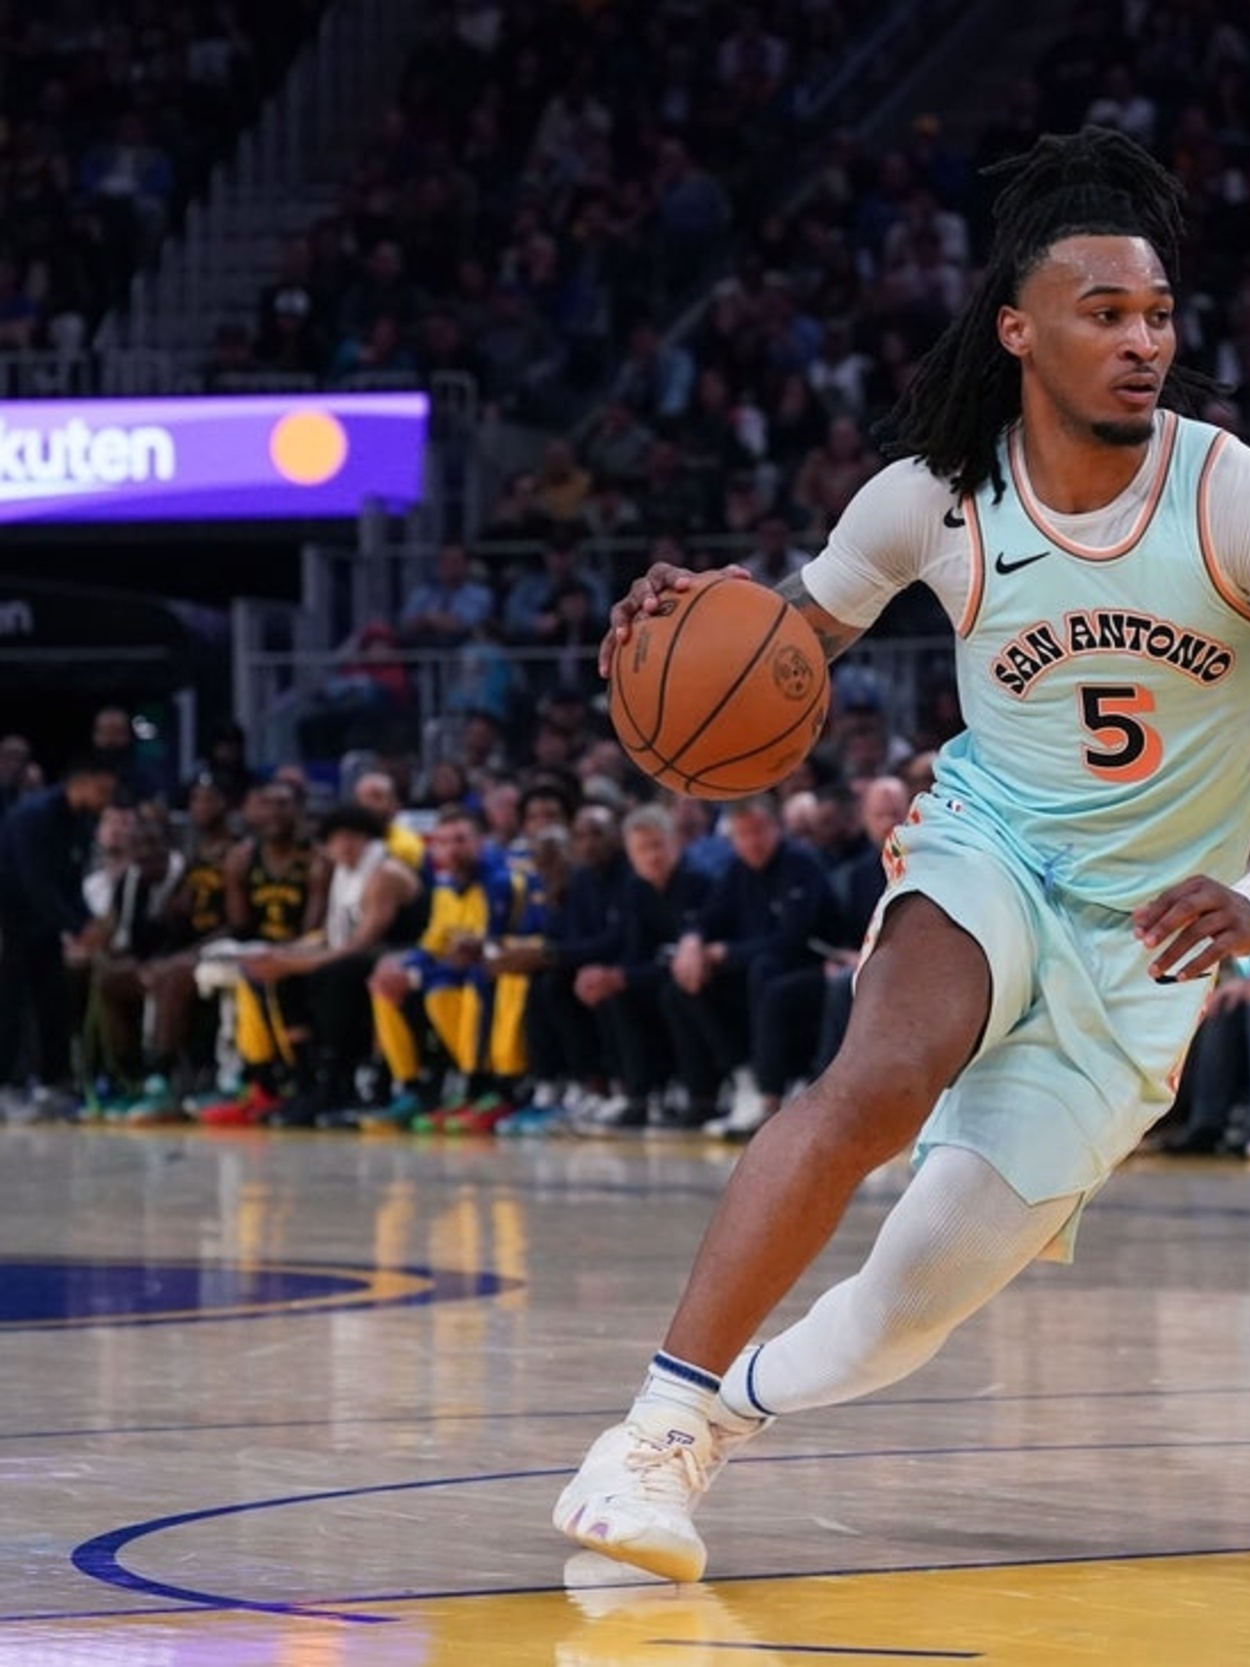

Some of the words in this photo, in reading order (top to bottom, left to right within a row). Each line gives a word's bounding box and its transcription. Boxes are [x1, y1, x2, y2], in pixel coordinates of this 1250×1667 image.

[994, 625, 1065, 695] SAN
[1068, 611, 1233, 684] ANTONIO
[1080, 684, 1160, 780] 5
